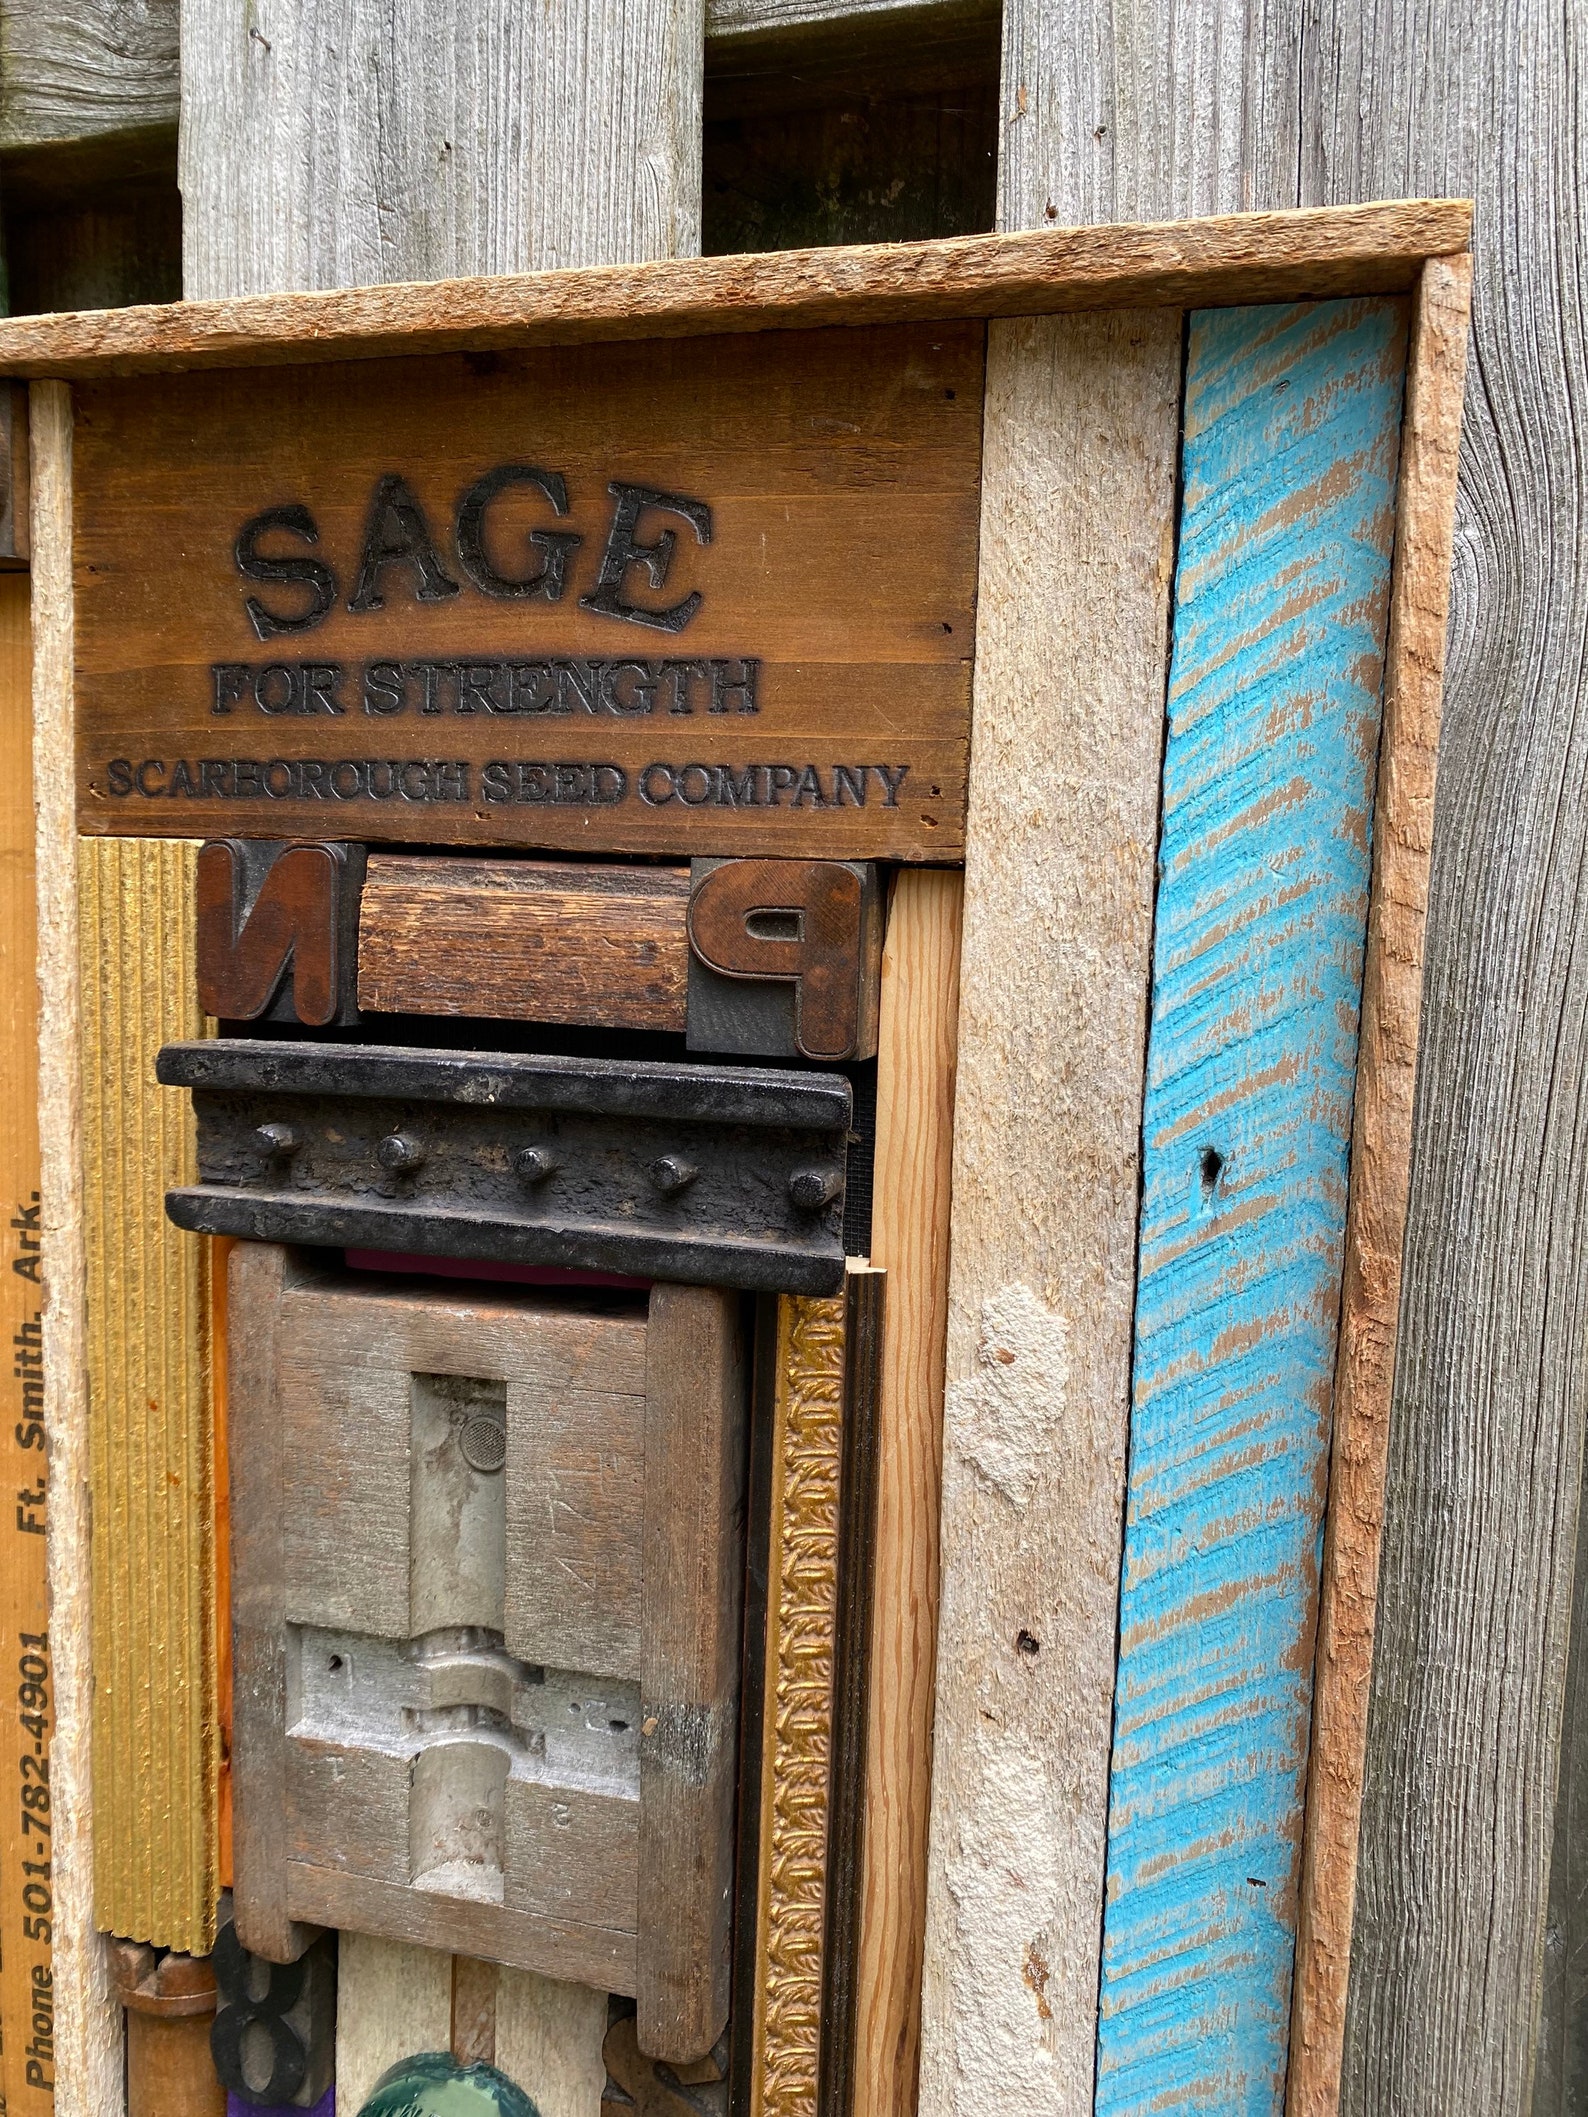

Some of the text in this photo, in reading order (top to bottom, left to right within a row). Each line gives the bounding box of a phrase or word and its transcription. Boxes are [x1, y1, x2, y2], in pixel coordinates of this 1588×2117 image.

[235, 465, 711, 641] SAGE
[211, 658, 761, 715] FOR STRENGTH
[107, 758, 909, 808] SCARBOROUGH SEED COMPANY
[10, 1191, 41, 1284] Ark.
[16, 1477, 47, 1536] Ft.
[18, 1632, 51, 1945] 501-782-4901
[25, 1965, 54, 2092] Phone
